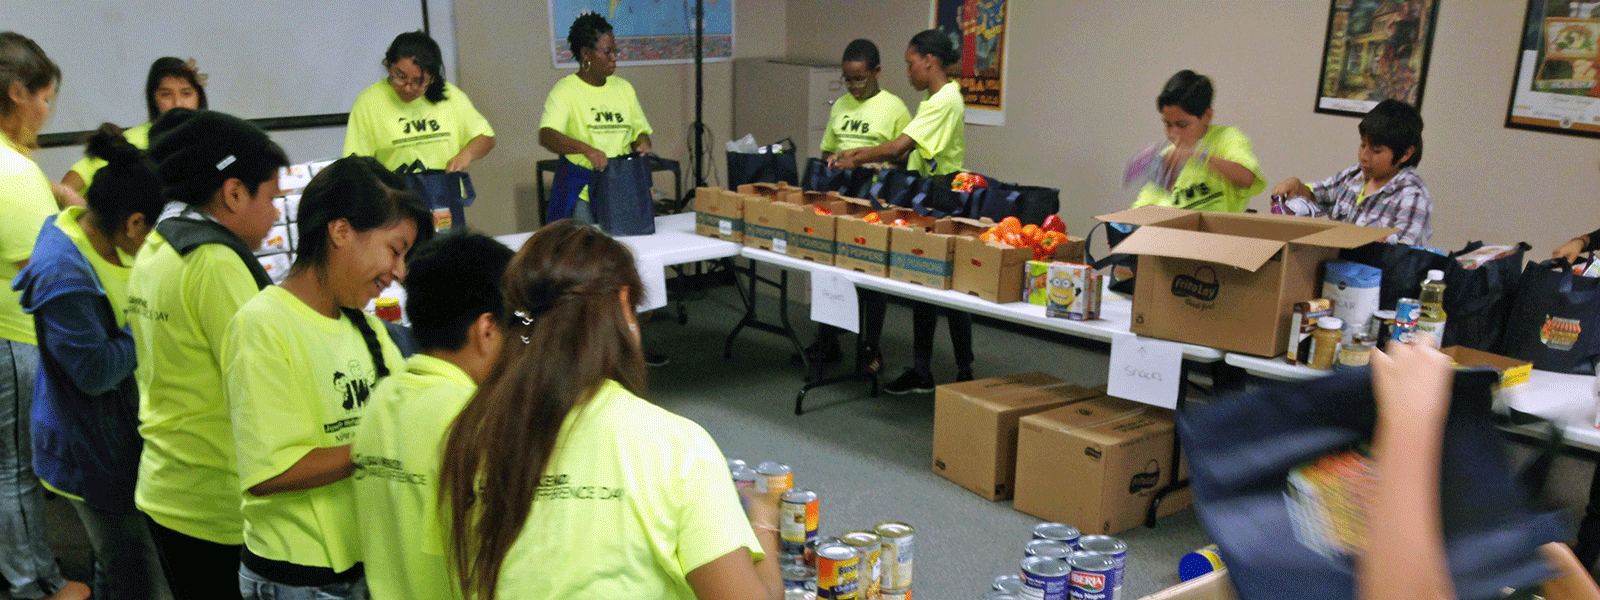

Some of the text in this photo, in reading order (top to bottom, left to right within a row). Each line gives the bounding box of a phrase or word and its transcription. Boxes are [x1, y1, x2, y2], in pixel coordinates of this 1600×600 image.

[595, 111, 624, 123] JWB
[403, 118, 440, 134] JWB
[841, 119, 870, 134] JWB
